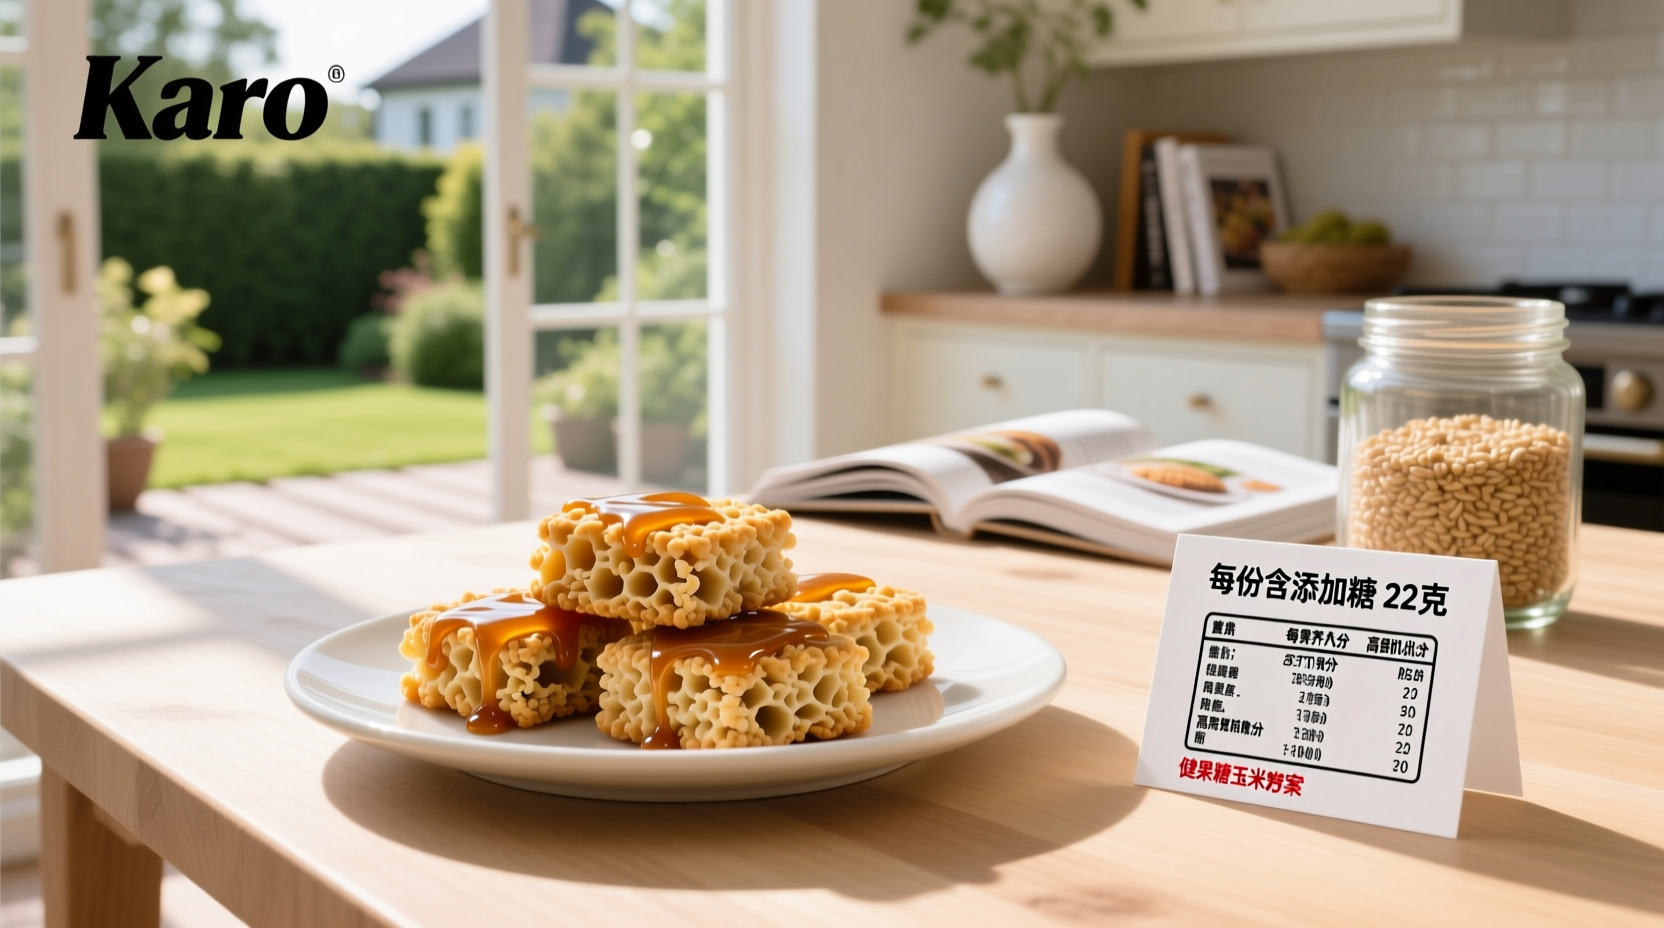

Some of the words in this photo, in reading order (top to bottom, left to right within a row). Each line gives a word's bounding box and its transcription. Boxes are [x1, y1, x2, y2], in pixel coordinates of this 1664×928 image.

[1209, 562, 1377, 610] 每份含添加糖
[1383, 582, 1450, 617] 22克
[1402, 687, 1418, 700] 20
[1400, 705, 1416, 719] 30
[1398, 723, 1413, 737] 20
